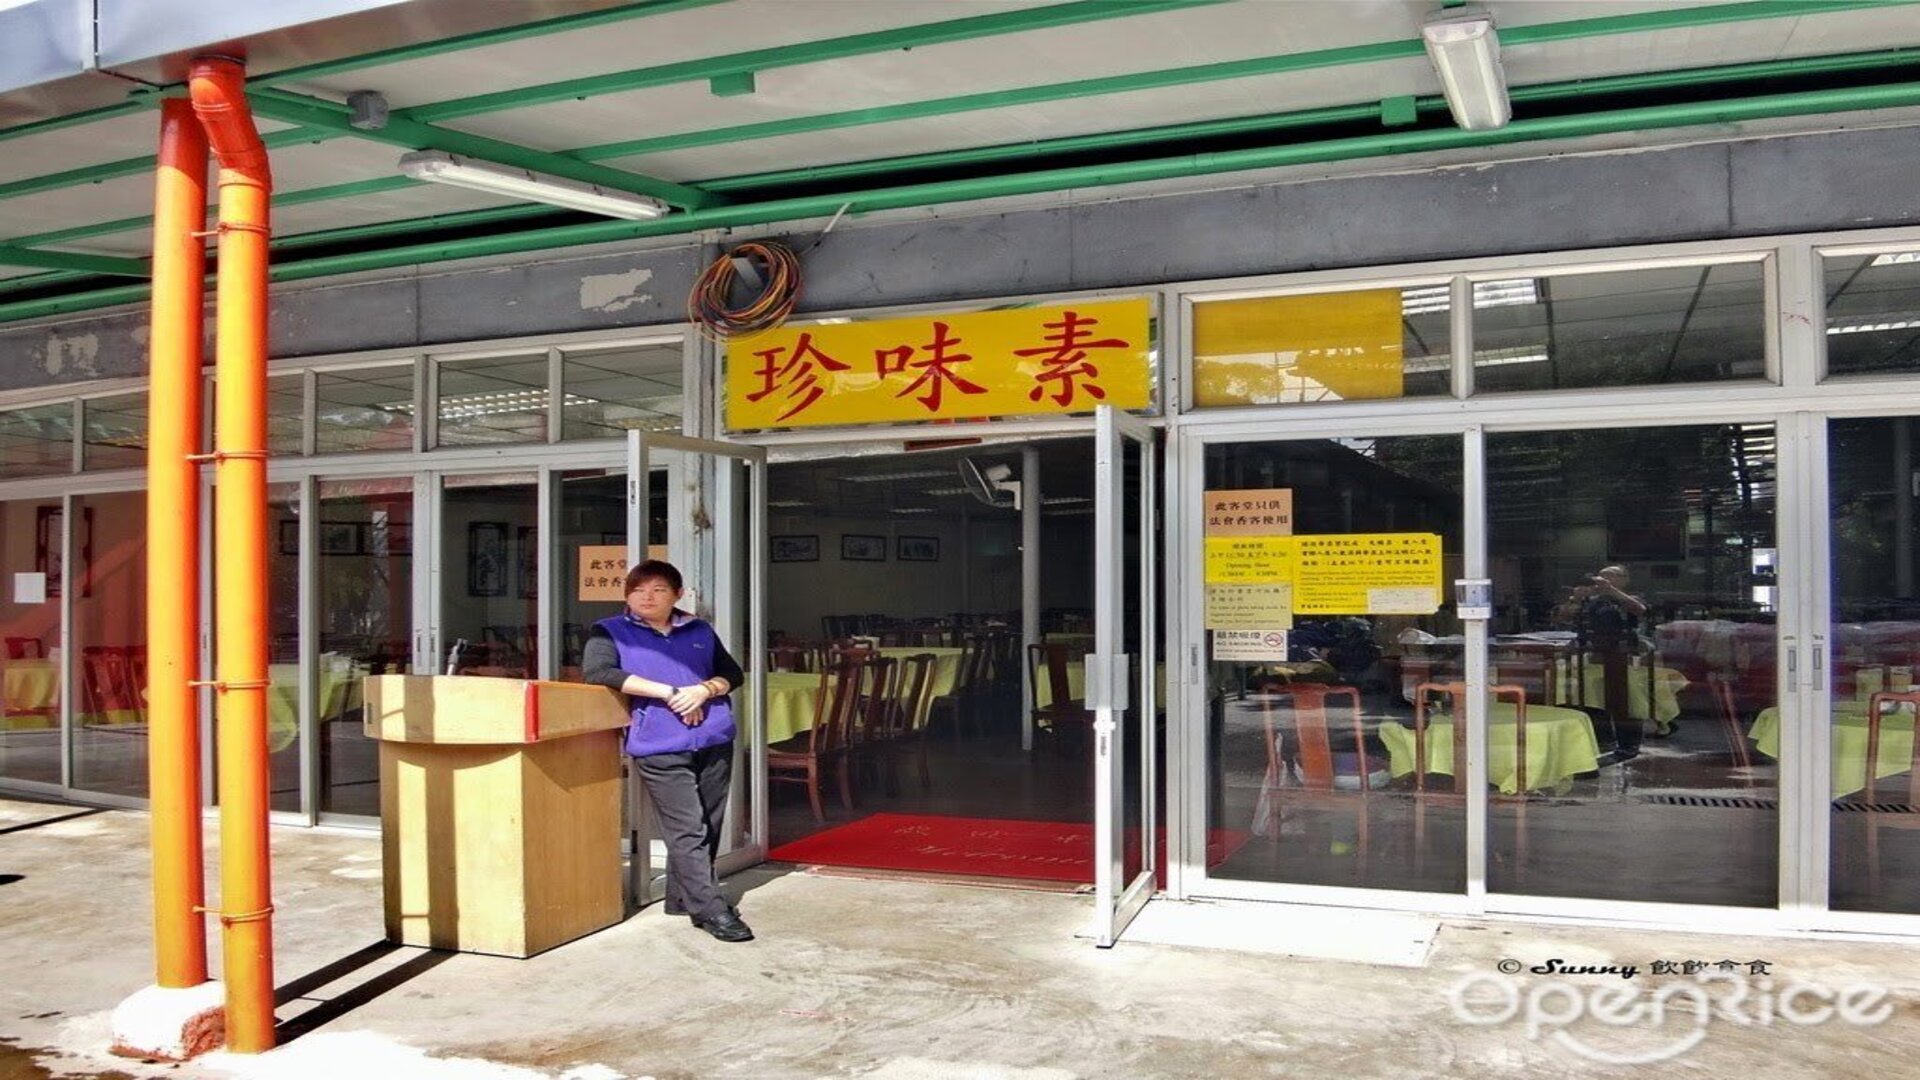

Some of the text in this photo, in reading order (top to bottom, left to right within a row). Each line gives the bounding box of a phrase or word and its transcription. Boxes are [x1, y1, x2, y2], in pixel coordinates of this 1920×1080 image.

[1215, 500, 1280, 511] 此客堂只供
[1209, 515, 1288, 526] 法會香客使用
